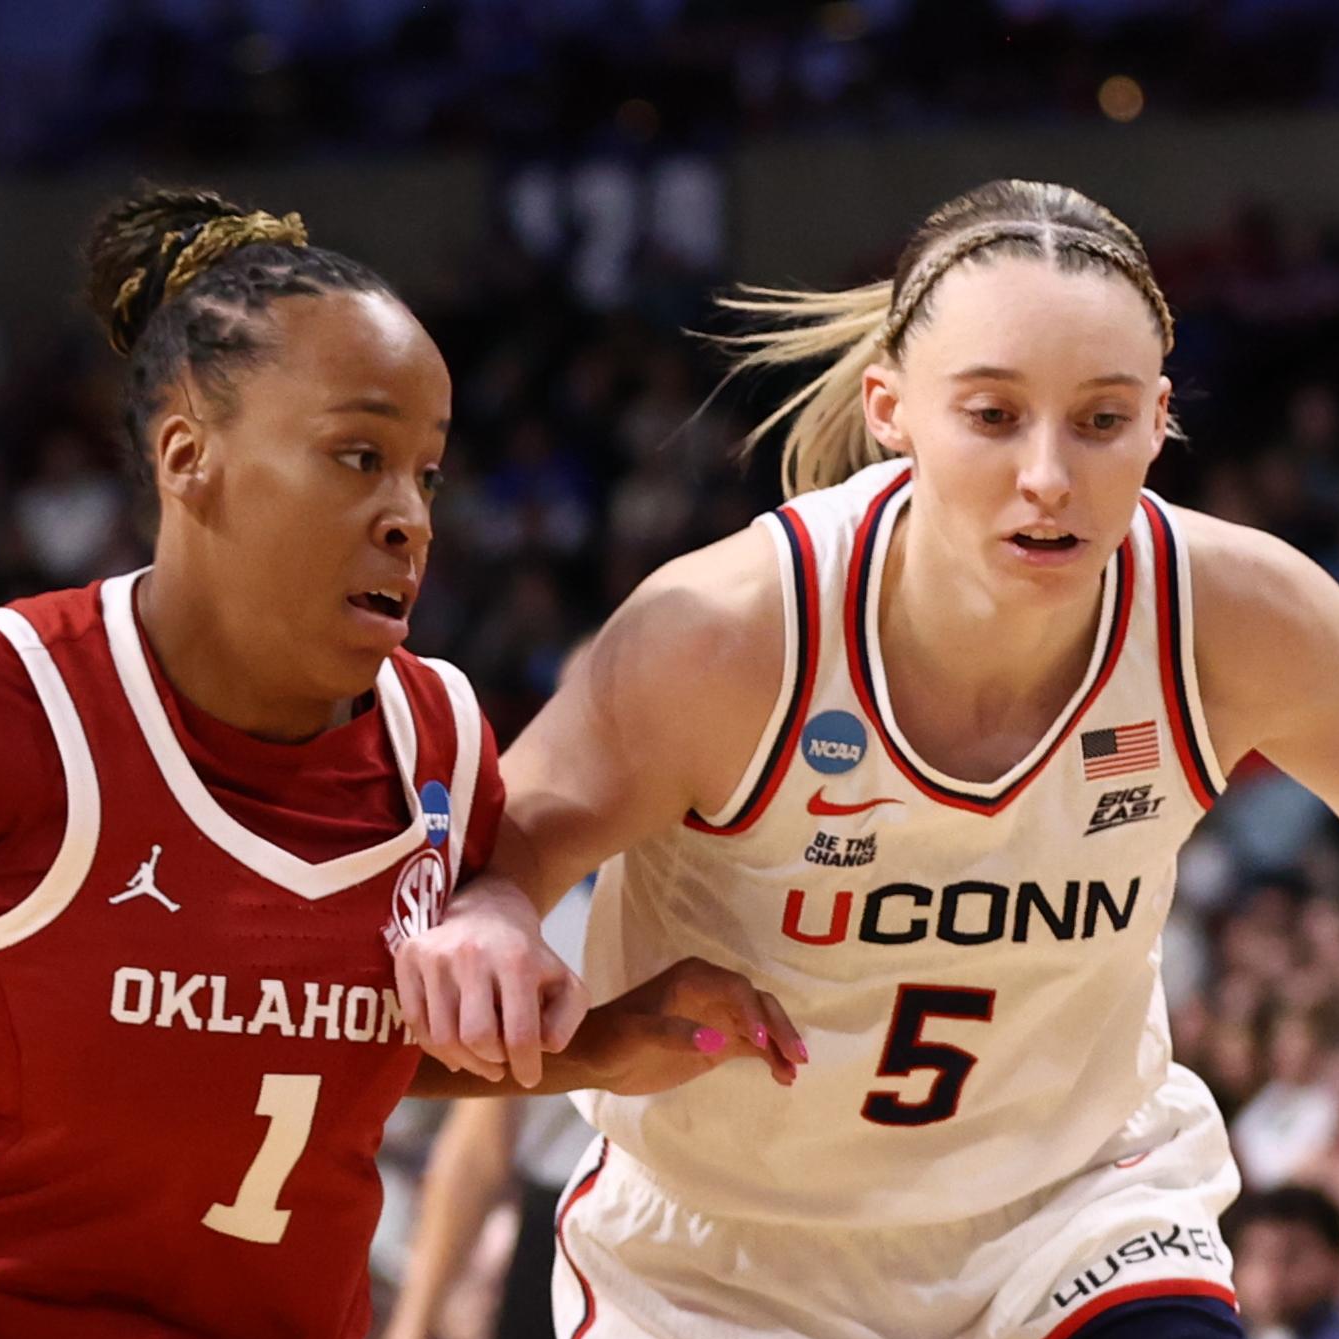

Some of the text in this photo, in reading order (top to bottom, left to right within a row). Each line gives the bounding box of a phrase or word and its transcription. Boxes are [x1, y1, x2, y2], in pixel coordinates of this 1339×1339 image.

[808, 739, 861, 762] NCAA
[1089, 796, 1166, 826] EAST
[1097, 784, 1153, 808] BIG
[804, 845, 877, 868] CHANGE
[814, 831, 877, 853] BE THE
[781, 877, 1142, 946] UCONN
[109, 966, 419, 1045] OKLAHOM
[860, 982, 997, 1127] 5
[201, 1073, 322, 1245] 1
